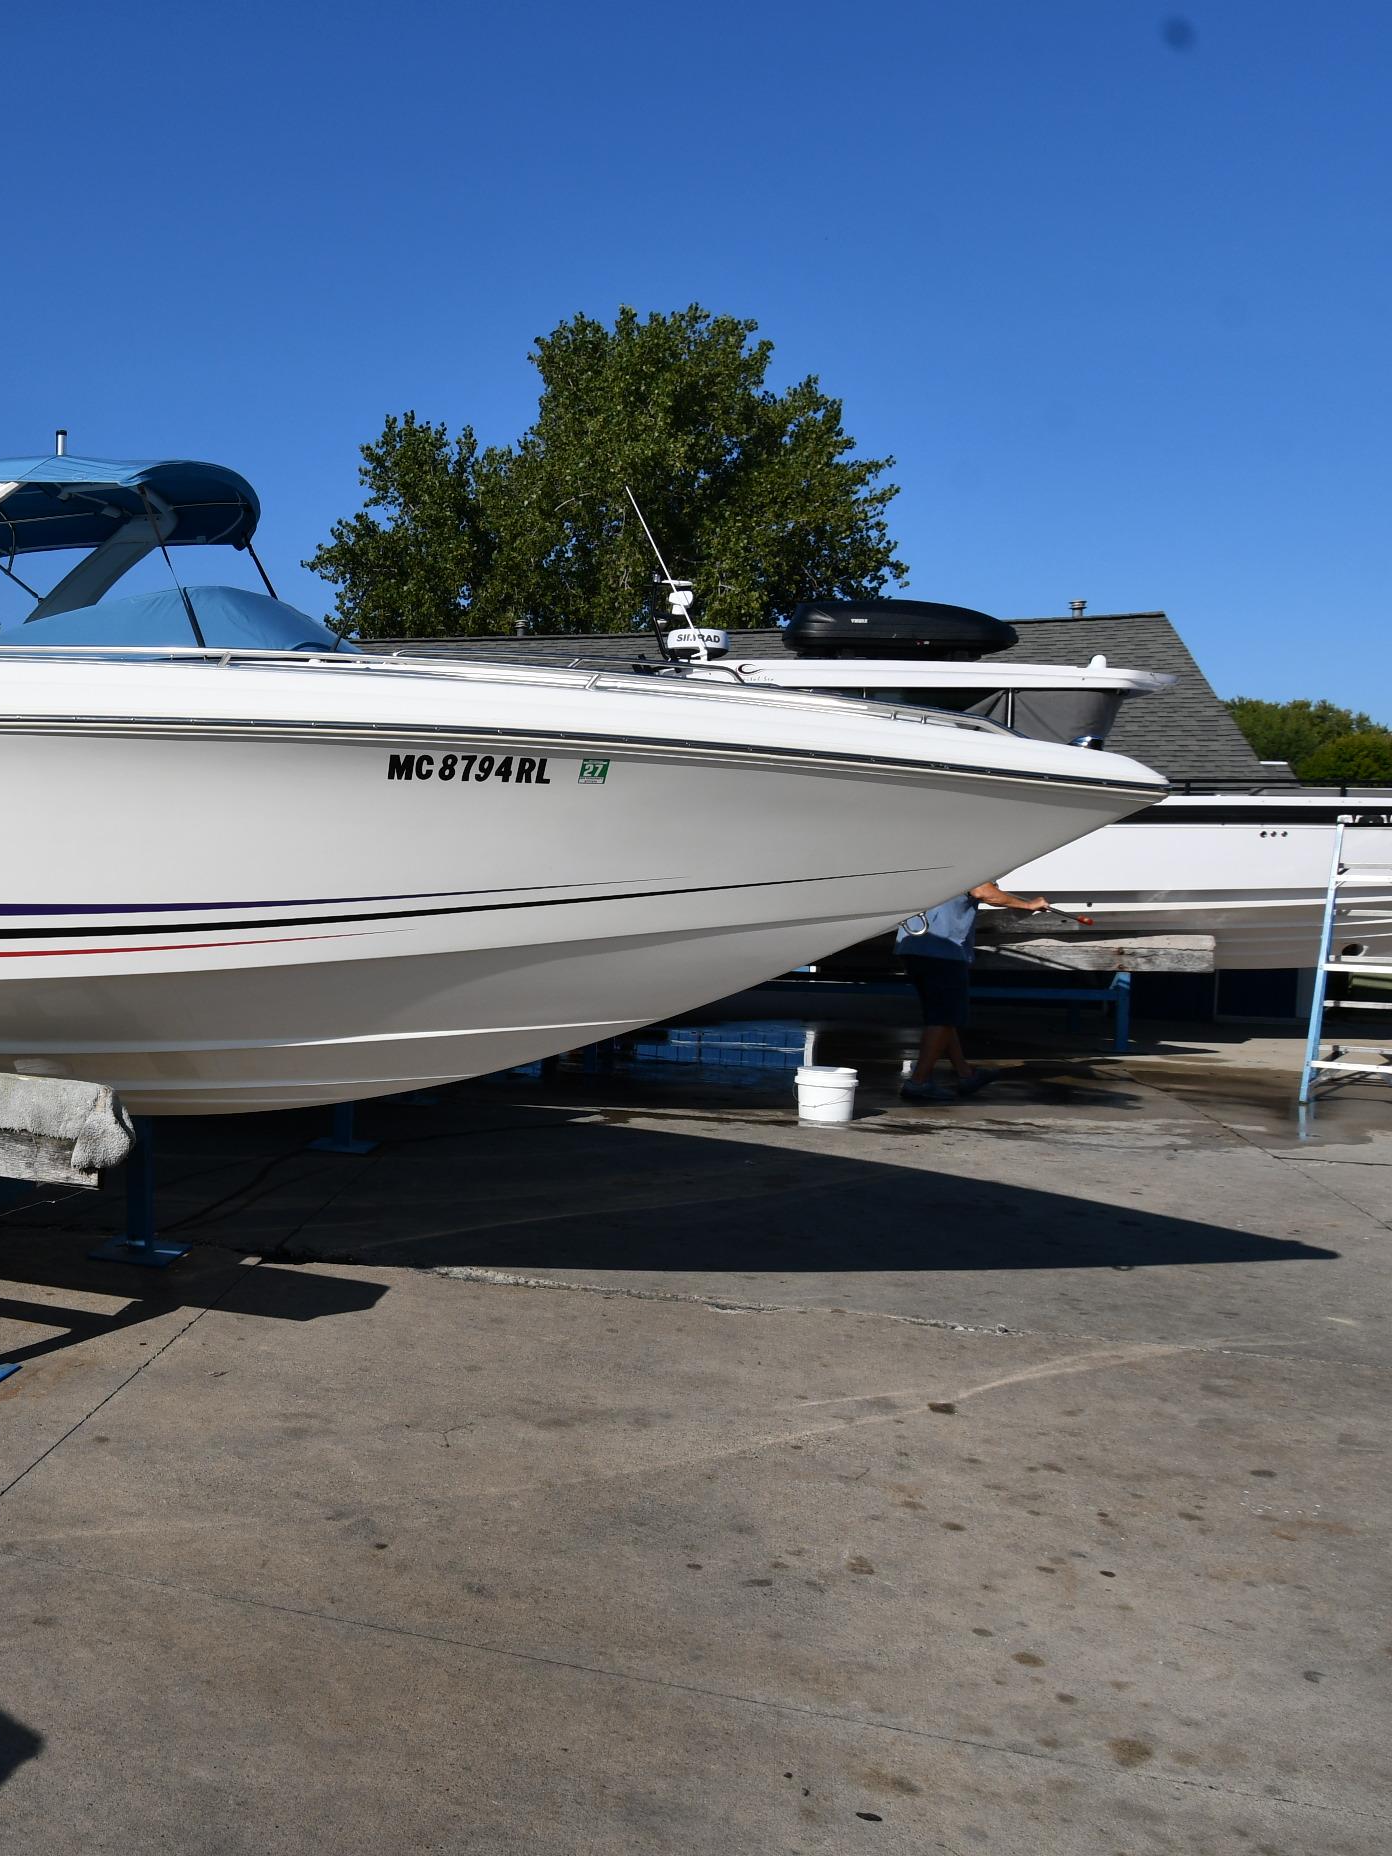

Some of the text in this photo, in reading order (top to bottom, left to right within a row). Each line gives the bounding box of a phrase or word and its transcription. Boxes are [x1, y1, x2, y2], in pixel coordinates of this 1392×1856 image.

[388, 754, 551, 785] MC 8794 RL
[583, 764, 604, 777] 27
